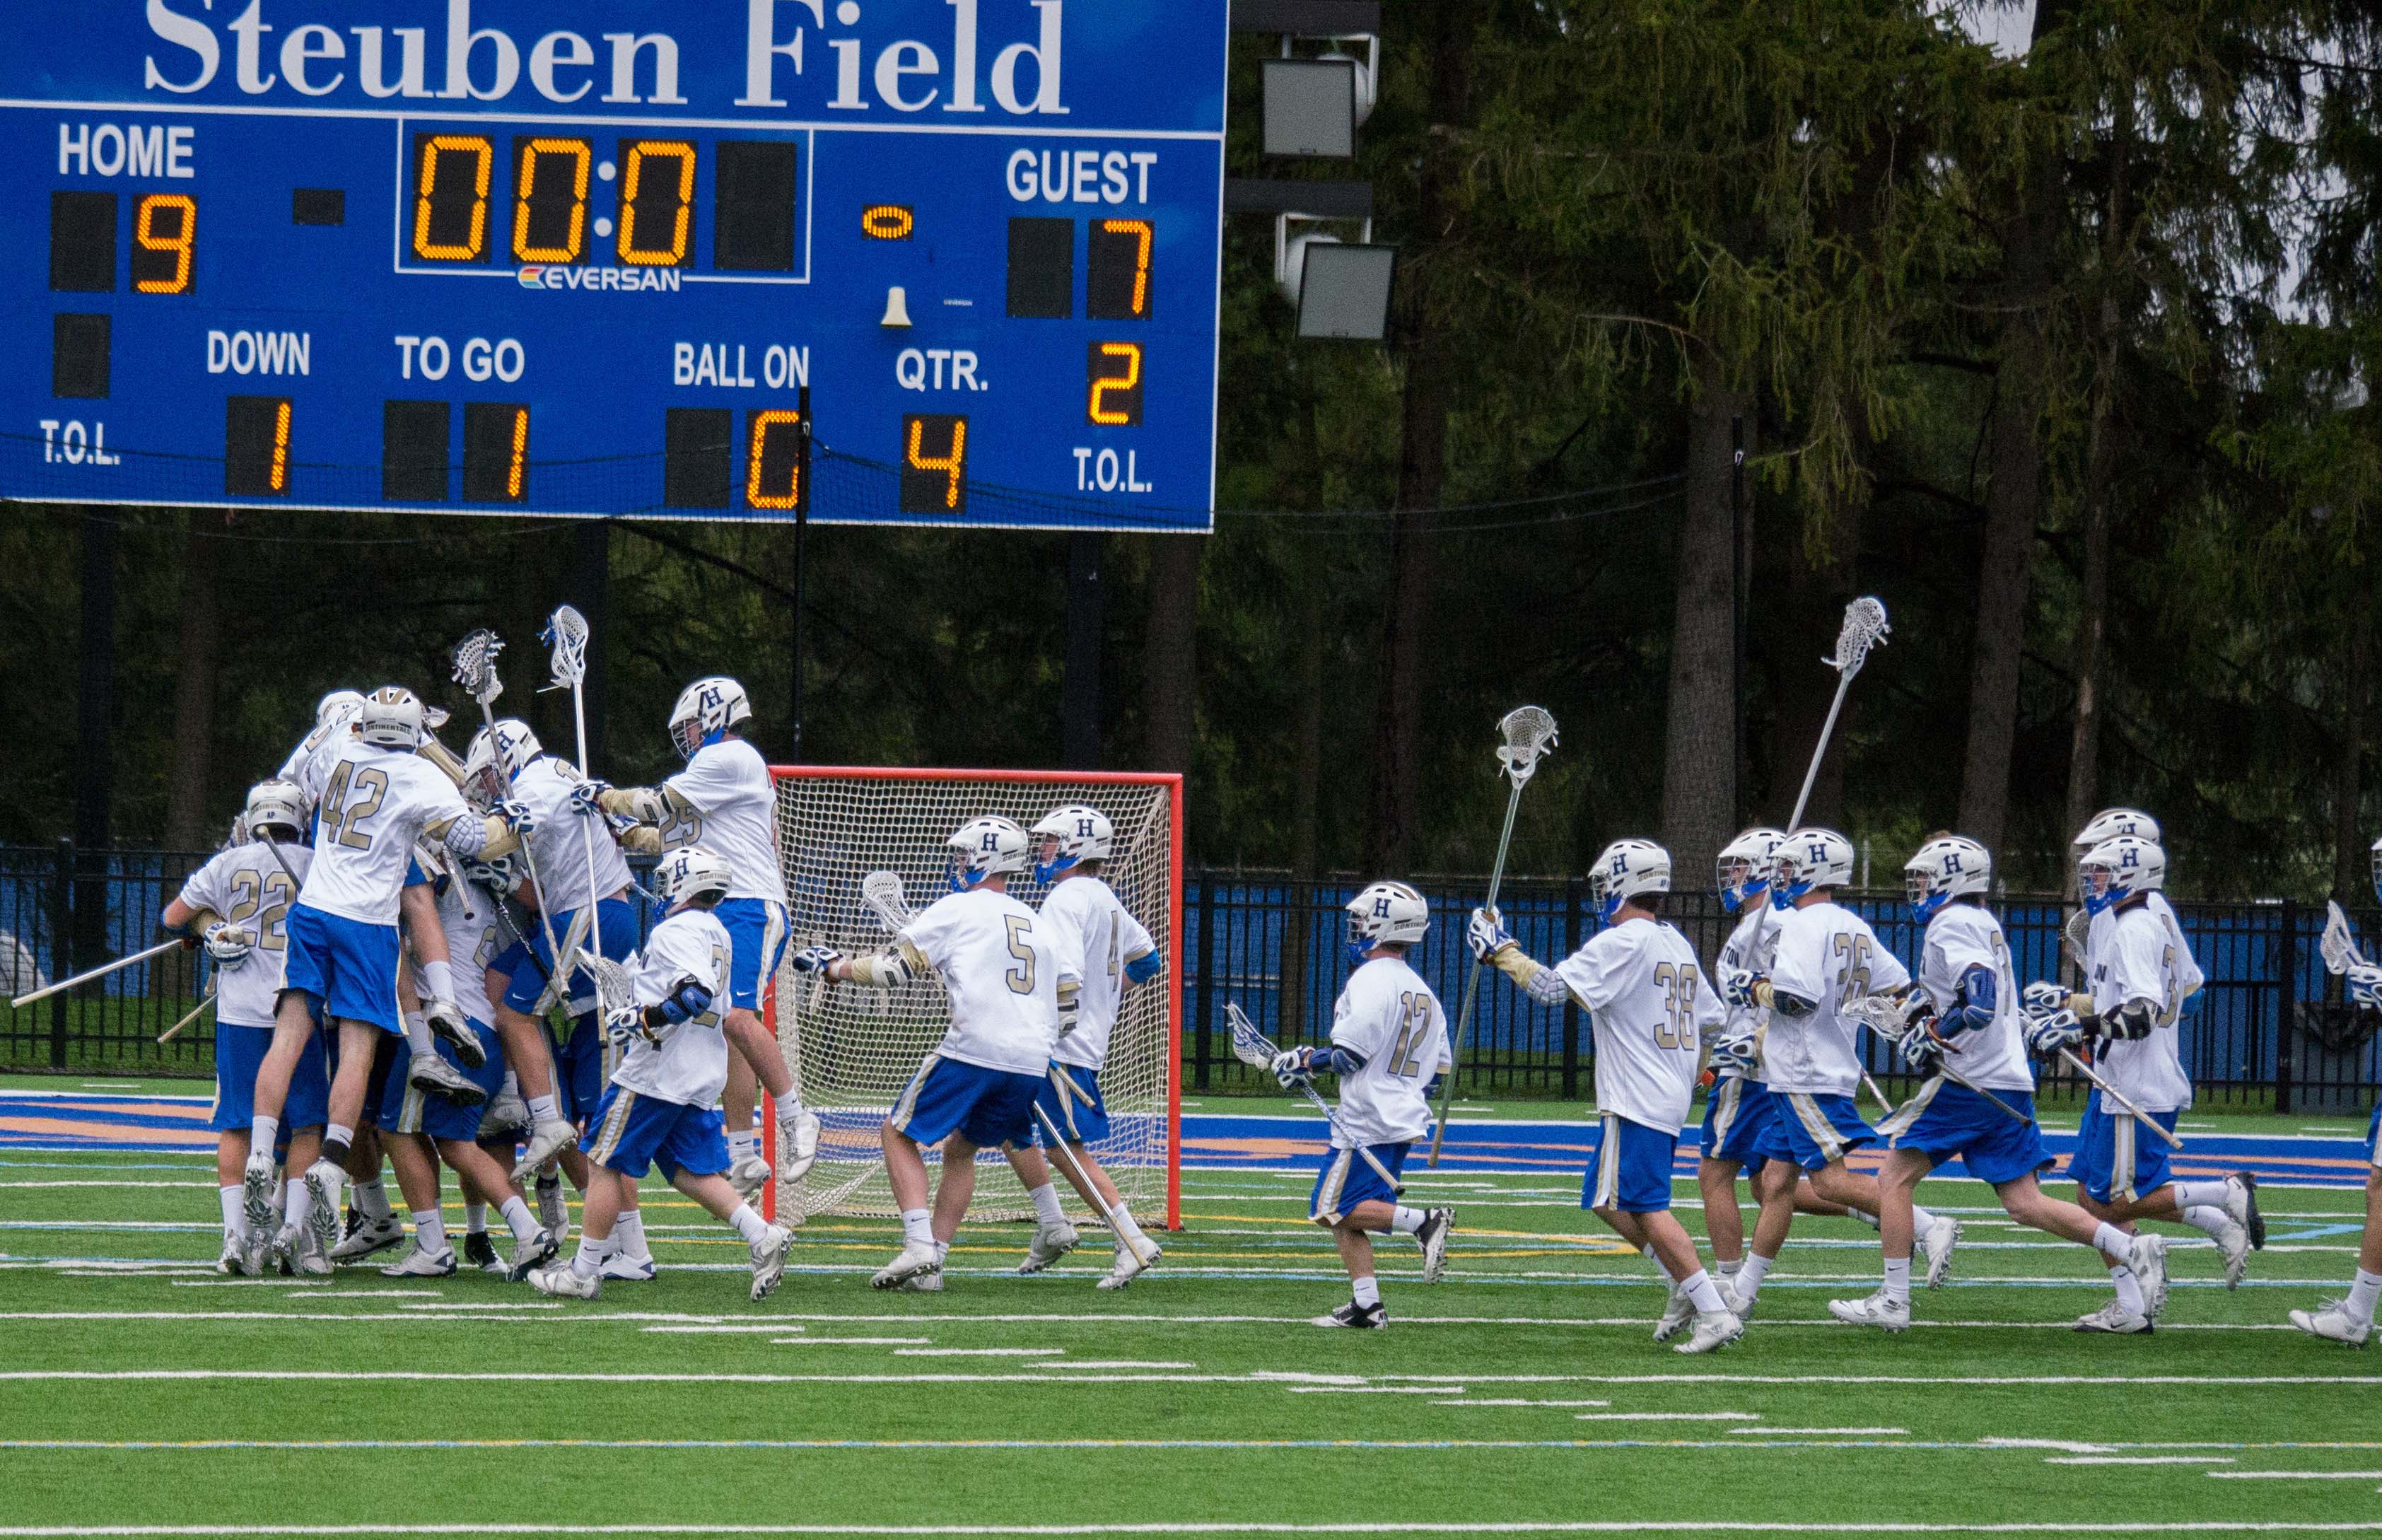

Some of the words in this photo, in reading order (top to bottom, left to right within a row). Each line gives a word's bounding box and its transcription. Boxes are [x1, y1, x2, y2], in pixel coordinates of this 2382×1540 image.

[144, 0, 688, 106] Steuben
[733, 0, 1071, 115] Field
[58, 123, 195, 178] HOME
[1006, 148, 1157, 205] GUEST
[137, 194, 197, 294] 9
[1103, 219, 1152, 315] 7
[544, 266, 680, 292] EVERSAN
[206, 330, 310, 376] DOWN
[394, 336, 450, 380] TO
[462, 338, 525, 383] GO
[673, 342, 755, 387] BALL
[764, 345, 809, 389] ON
[895, 348, 989, 392] QTR.
[1090, 342, 1140, 425] 2
[40, 420, 121, 465] T.O.L.
[269, 402, 291, 491] 1
[507, 409, 528, 498] 1
[908, 420, 967, 508] 4
[1073, 447, 1153, 493] T.O.L.
[703, 687, 724, 709] H
[321, 759, 389, 851] 42
[1077, 819, 1094, 837] H
[981, 832, 999, 852] H
[1611, 853, 1630, 875] H
[1809, 844, 1828, 863] H
[1944, 853, 1963, 875] H
[2120, 848, 2139, 867] H
[675, 857, 689, 878] H
[230, 869, 298, 951] 22
[1372, 897, 1392, 918] H
[1003, 914, 1036, 996] 5
[1833, 933, 1873, 1017] 26
[1653, 962, 1699, 1052] 38
[1388, 991, 1432, 1078] 12
